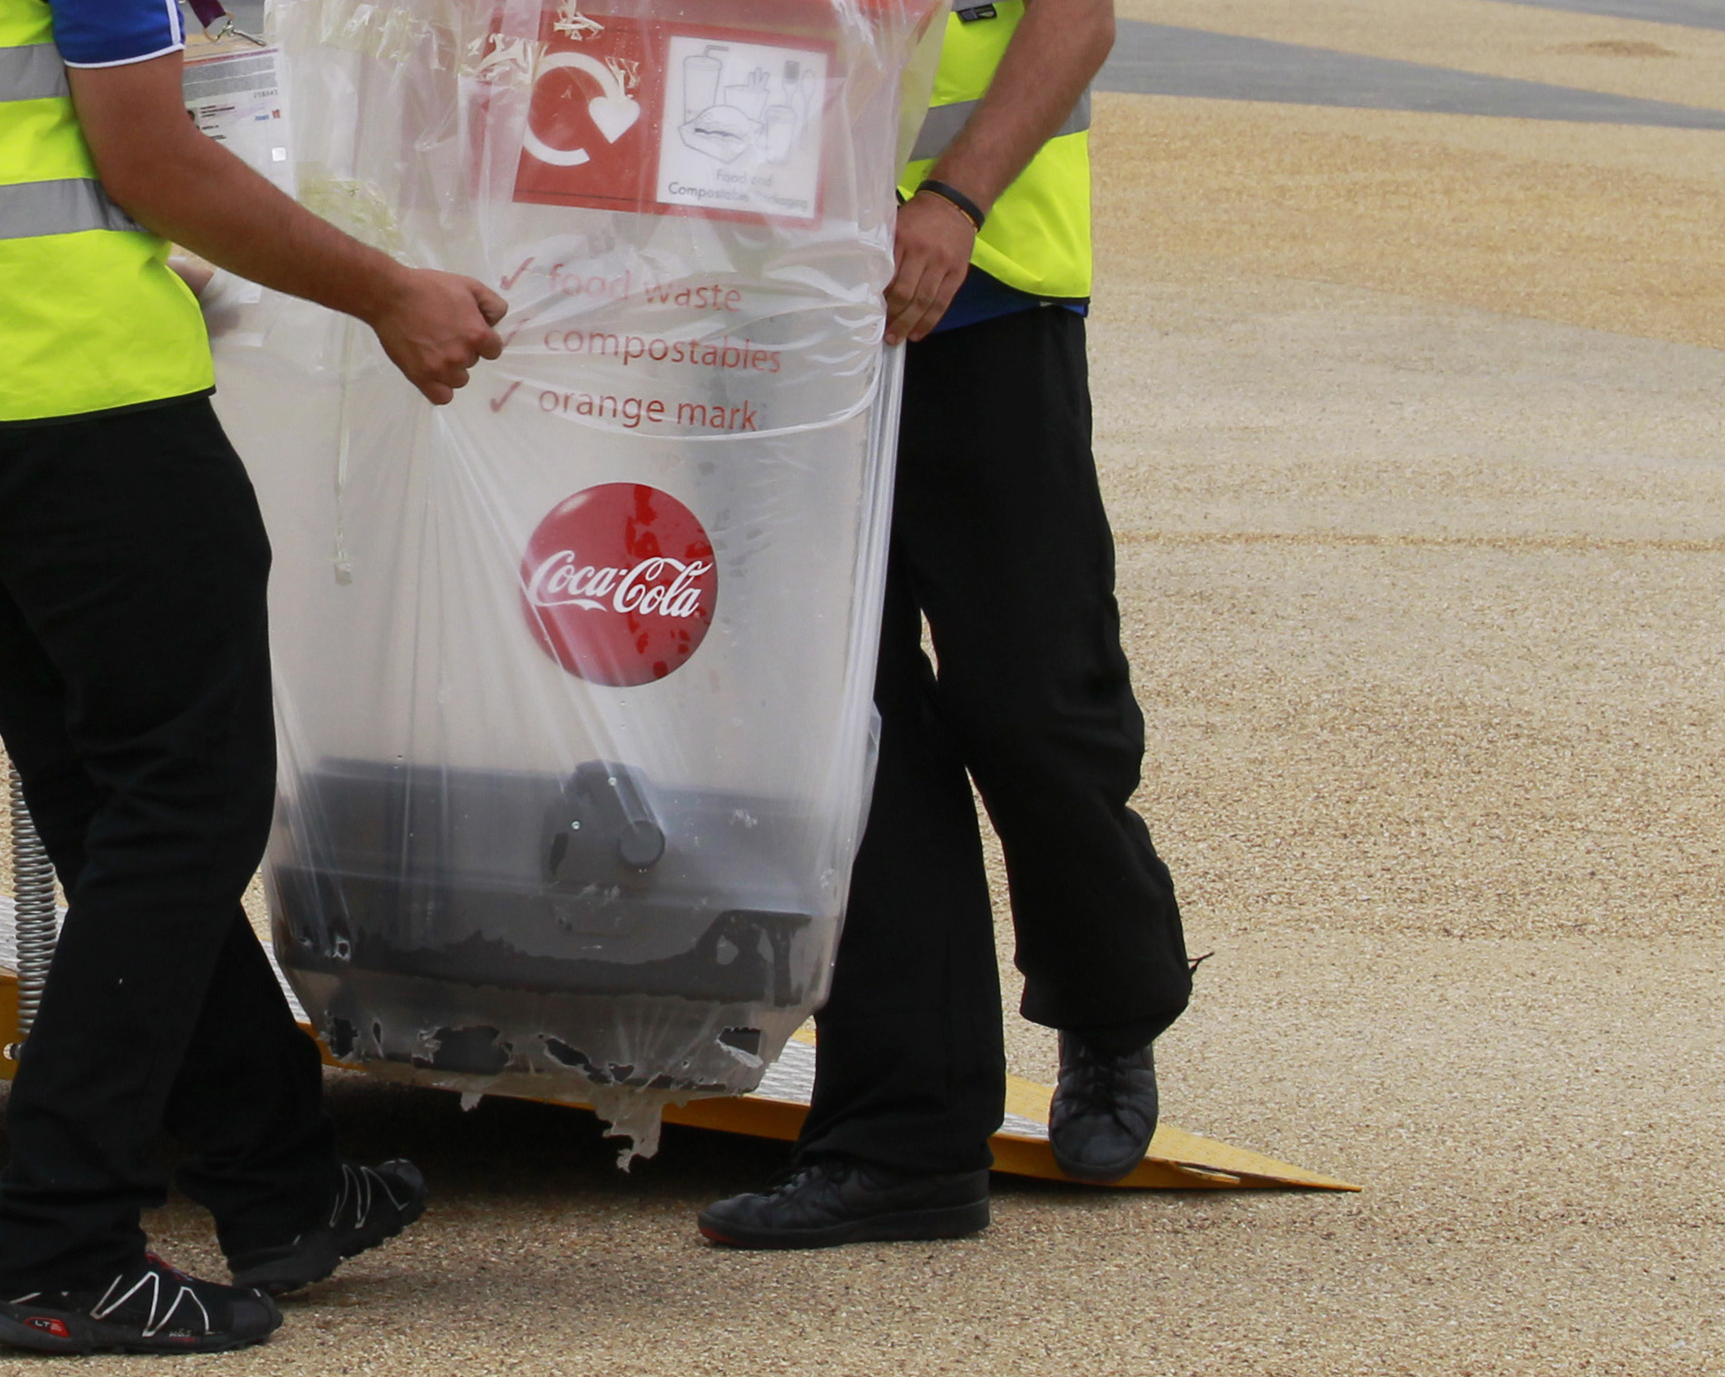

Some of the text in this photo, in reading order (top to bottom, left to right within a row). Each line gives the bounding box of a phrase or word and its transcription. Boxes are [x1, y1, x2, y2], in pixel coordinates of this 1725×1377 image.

[716, 169, 747, 185] Food
[549, 263, 742, 313] food waste
[543, 328, 782, 375] compostables
[538, 387, 758, 432] orange mark
[527, 549, 714, 618] Coca-Cola
